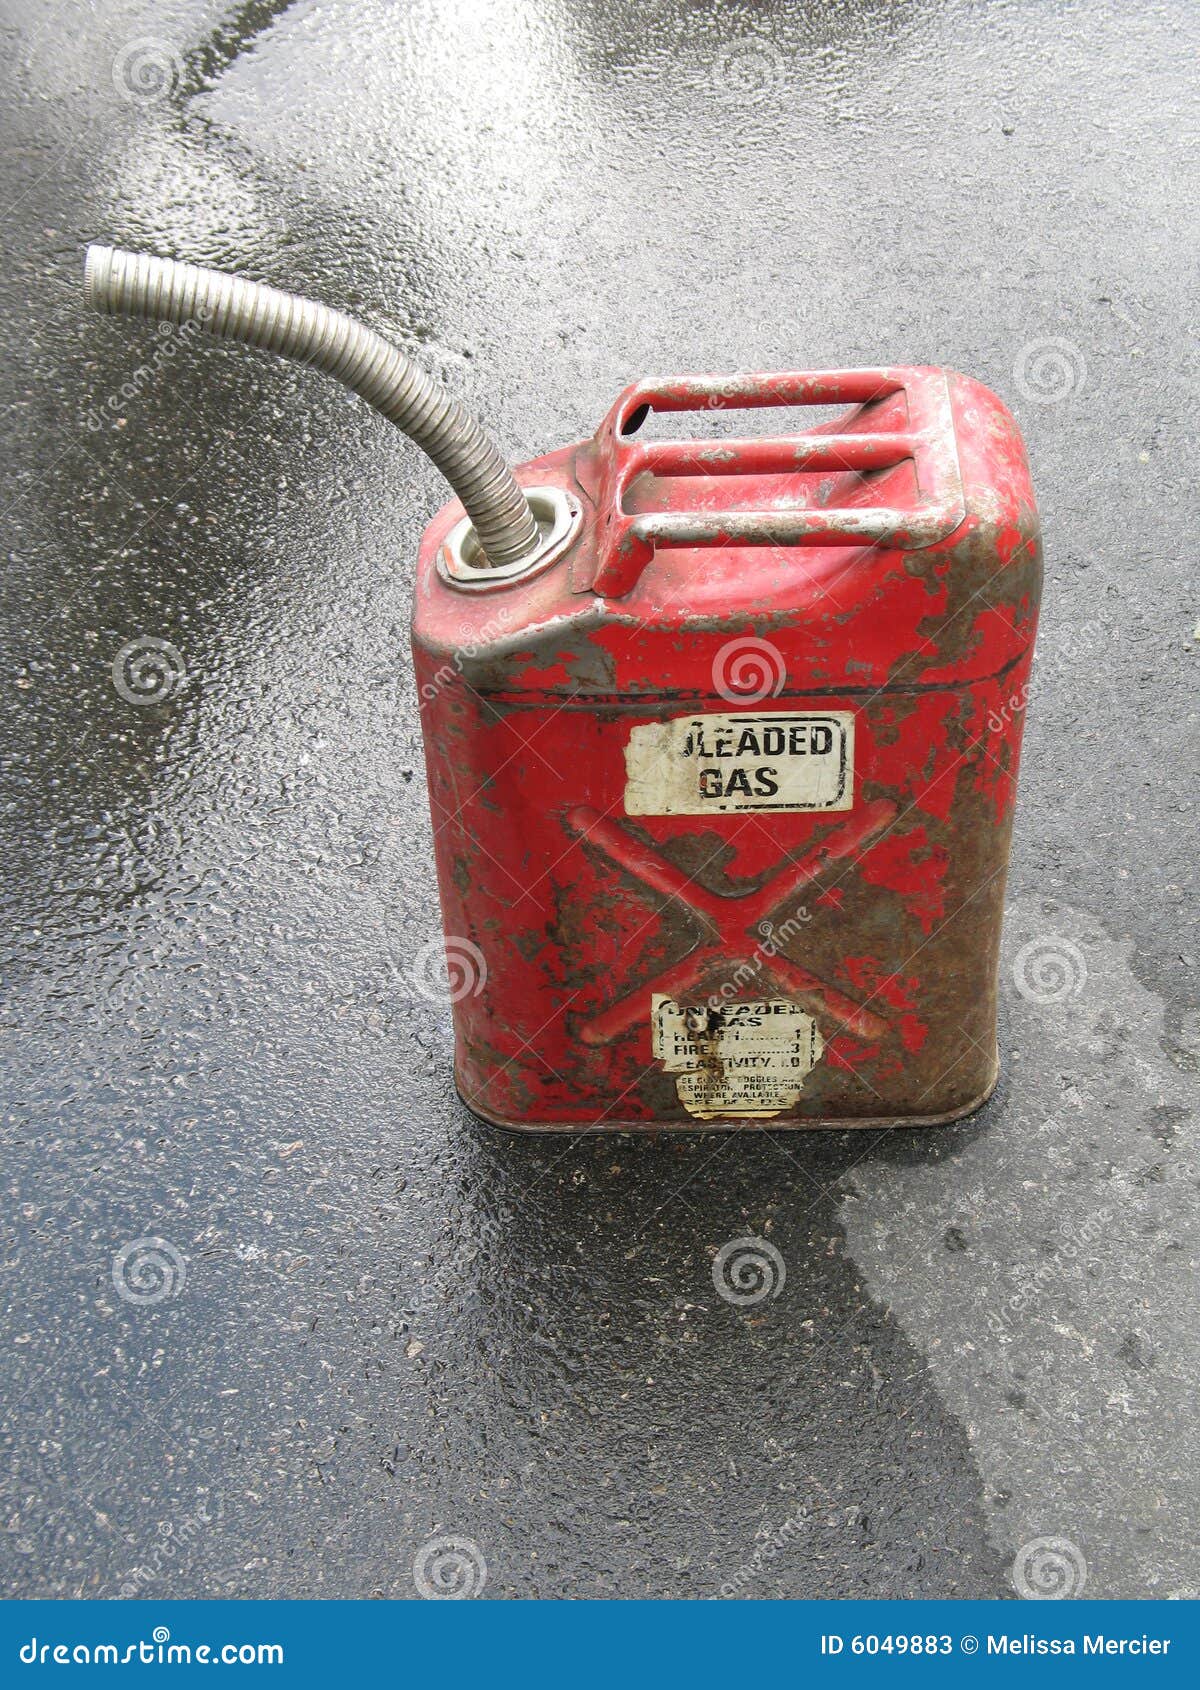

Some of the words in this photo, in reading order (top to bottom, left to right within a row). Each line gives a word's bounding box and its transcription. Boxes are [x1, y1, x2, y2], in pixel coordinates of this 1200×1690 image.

[699, 766, 779, 799] GAS
[668, 1004, 804, 1016] UNEADE
[712, 1017, 762, 1028] AS
[674, 1045, 709, 1056] FIRE
[790, 1043, 800, 1055] 3
[743, 1083, 801, 1091] PROTECTON
[732, 1091, 781, 1099] AVALABLE
